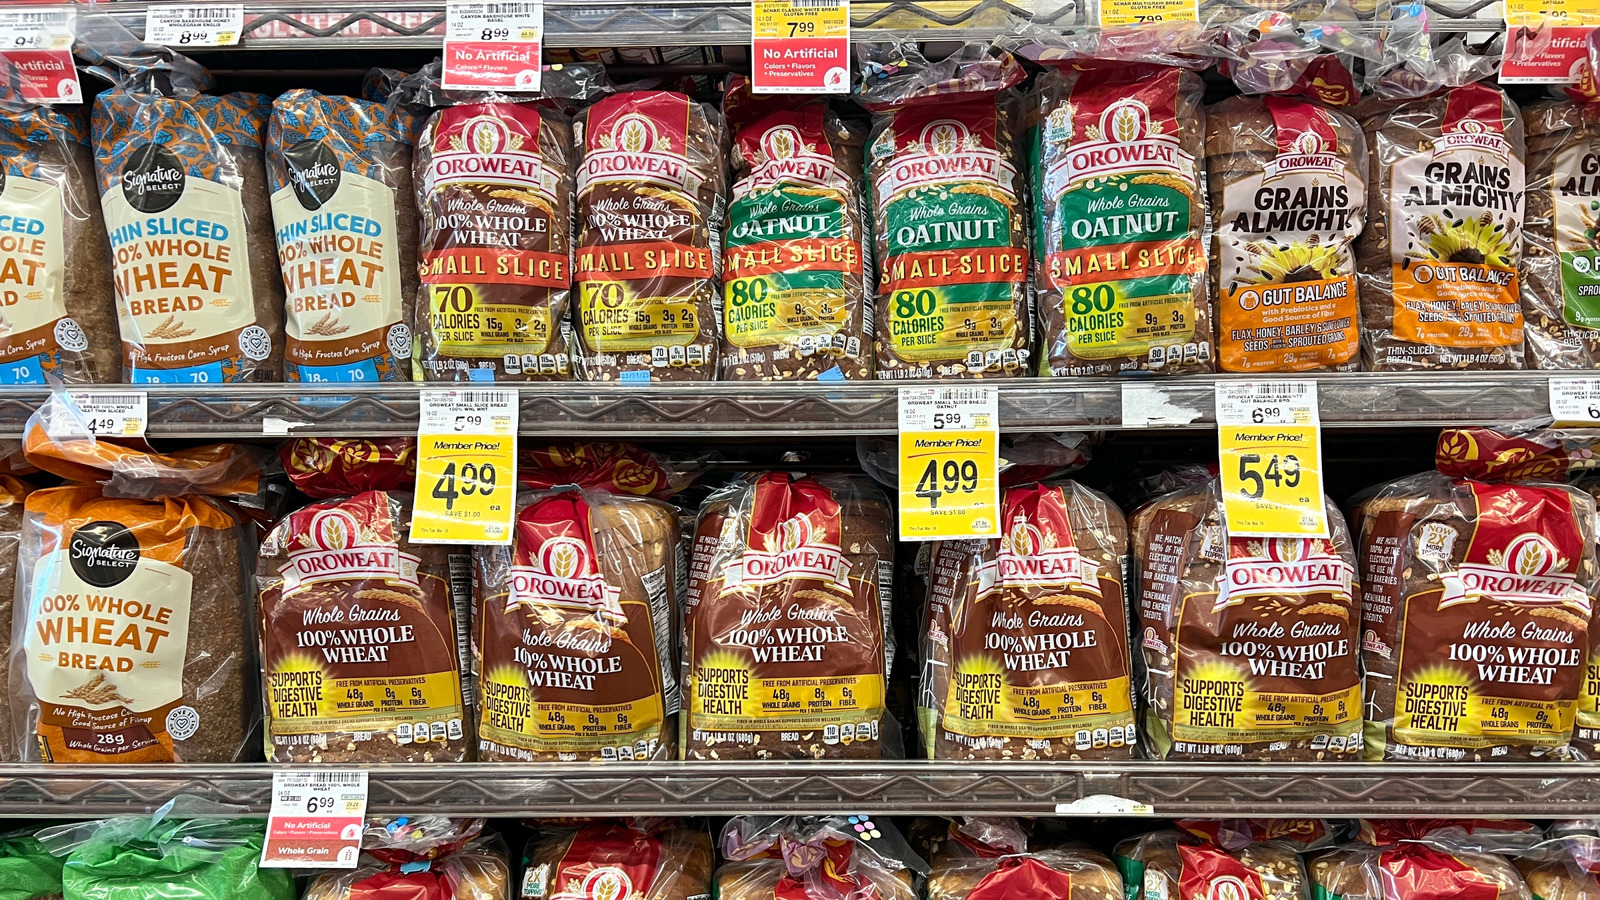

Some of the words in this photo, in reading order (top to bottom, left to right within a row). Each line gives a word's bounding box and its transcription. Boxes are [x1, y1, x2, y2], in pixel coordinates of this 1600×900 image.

[456, 50, 473, 60] No
[476, 50, 530, 62] Artificial
[763, 48, 781, 59] No
[784, 48, 838, 59] Artificial
[436, 158, 538, 178] OROWEAT
[1072, 145, 1174, 171] OROWEAT
[1278, 155, 1334, 170] OROWEAT
[588, 159, 684, 179] OROWEAT
[896, 159, 995, 181] OROWEAT
[1425, 162, 1510, 190] GRAINS
[124, 163, 182, 199] Signature
[146, 182, 180, 190] SELECT
[1087, 198, 1124, 214] Whole
[1128, 193, 1170, 208] Grains
[1254, 185, 1349, 210] GRAINS
[1404, 184, 1522, 214] ALMIGHTY
[146, 216, 229, 242] SLICED
[434, 213, 474, 232] 100%
[478, 216, 548, 234] WHOLE
[897, 219, 999, 246] OATNUT
[1072, 212, 1178, 240] OATNUT
[454, 231, 522, 248] WHEAT
[146, 238, 232, 264] WHOLE
[420, 254, 486, 278] SMALL
[500, 256, 564, 281] SLICE
[880, 259, 951, 284] SMALL
[961, 254, 1024, 277] SLICE
[1051, 251, 1130, 278] SMALL
[1138, 246, 1196, 270] SLICE
[435, 286, 474, 314] 70
[895, 289, 936, 319] 80
[1072, 284, 1116, 316] 80
[1262, 289, 1294, 308] GUT
[1296, 281, 1348, 302] BALANCE
[131, 296, 204, 316] BREAD
[432, 313, 480, 331] CALORIES
[892, 316, 945, 336] CALORIES
[964, 318, 977, 331] 9g
[990, 316, 1002, 329] 3g
[1070, 312, 1124, 333] CALORIES
[1078, 334, 1090, 344] PER
[1092, 331, 1116, 342] SLICE
[1232, 329, 1254, 342] FLAX,
[1256, 327, 1284, 340] HONEY,
[1285, 324, 1315, 338] BARLEY
[1244, 340, 1268, 352] SEEDS
[1288, 334, 1327, 348] SPROUTED
[137, 350, 152, 362] High
[154, 352, 186, 363] Fructose
[188, 349, 206, 360] Corn
[208, 342, 230, 356] Syrup
[1386, 345, 1435, 356] THIN-SLICED
[434, 441, 473, 450] Member
[474, 442, 500, 450] Price!
[914, 438, 954, 448] Member
[956, 438, 982, 448] Price!
[1235, 433, 1275, 442] Member
[1276, 433, 1304, 442] Price!
[1427, 522, 1453, 536] NOW
[1428, 532, 1446, 546] 2X
[71, 540, 137, 568] Signature
[1425, 544, 1444, 553] MORE
[96, 560, 130, 568] SELECT
[298, 551, 392, 574] OROWEAT
[1232, 565, 1340, 586] OROWEAT
[1463, 573, 1569, 597] OROWEAT
[86, 594, 174, 625] WHOLE
[302, 606, 344, 626] Whole
[348, 604, 402, 622] Grains
[36, 616, 170, 654] WHEAT
[296, 629, 342, 648] 100%
[342, 624, 415, 646] WHOLE
[728, 629, 774, 646] 100%
[777, 626, 848, 644] WHOLE
[1020, 630, 1097, 650] WHOLE
[1463, 620, 1516, 640] Whole
[1521, 622, 1574, 644] Grains
[58, 652, 134, 673] BREAD
[322, 646, 389, 664] WHEAT
[752, 644, 826, 664] WHEAT
[1004, 650, 1071, 672] WHEAT
[1448, 643, 1505, 664] 100%
[1508, 646, 1580, 667] WHOLE
[548, 654, 622, 675] WHOLE
[1248, 658, 1327, 680] WHEAT
[1477, 664, 1557, 685] WHEAT
[272, 670, 322, 688] SUPPORTS
[364, 678, 387, 687] ARTIFICIAL
[388, 677, 426, 686] PRESERVATIVES
[528, 670, 596, 691] WHEAT
[1183, 679, 1245, 697] SUPPORTS
[273, 686, 323, 703] DIGESTIVE
[336, 701, 356, 709] WHOLE
[356, 700, 374, 708] GRAINS
[409, 698, 427, 706] FIBER
[346, 688, 364, 701] 48g
[385, 687, 396, 699] 8g
[412, 686, 422, 698] 6g
[52, 707, 66, 716] No
[67, 708, 86, 720] High
[88, 710, 119, 721] Fructose
[278, 702, 318, 718] HEALTH
[1184, 696, 1242, 712] DIGESTIVE
[1190, 712, 1235, 728] HEALTH
[97, 733, 125, 746] 28g
[278, 846, 306, 855] Whole
[306, 846, 329, 855] Grain
[527, 870, 541, 882] 2X
